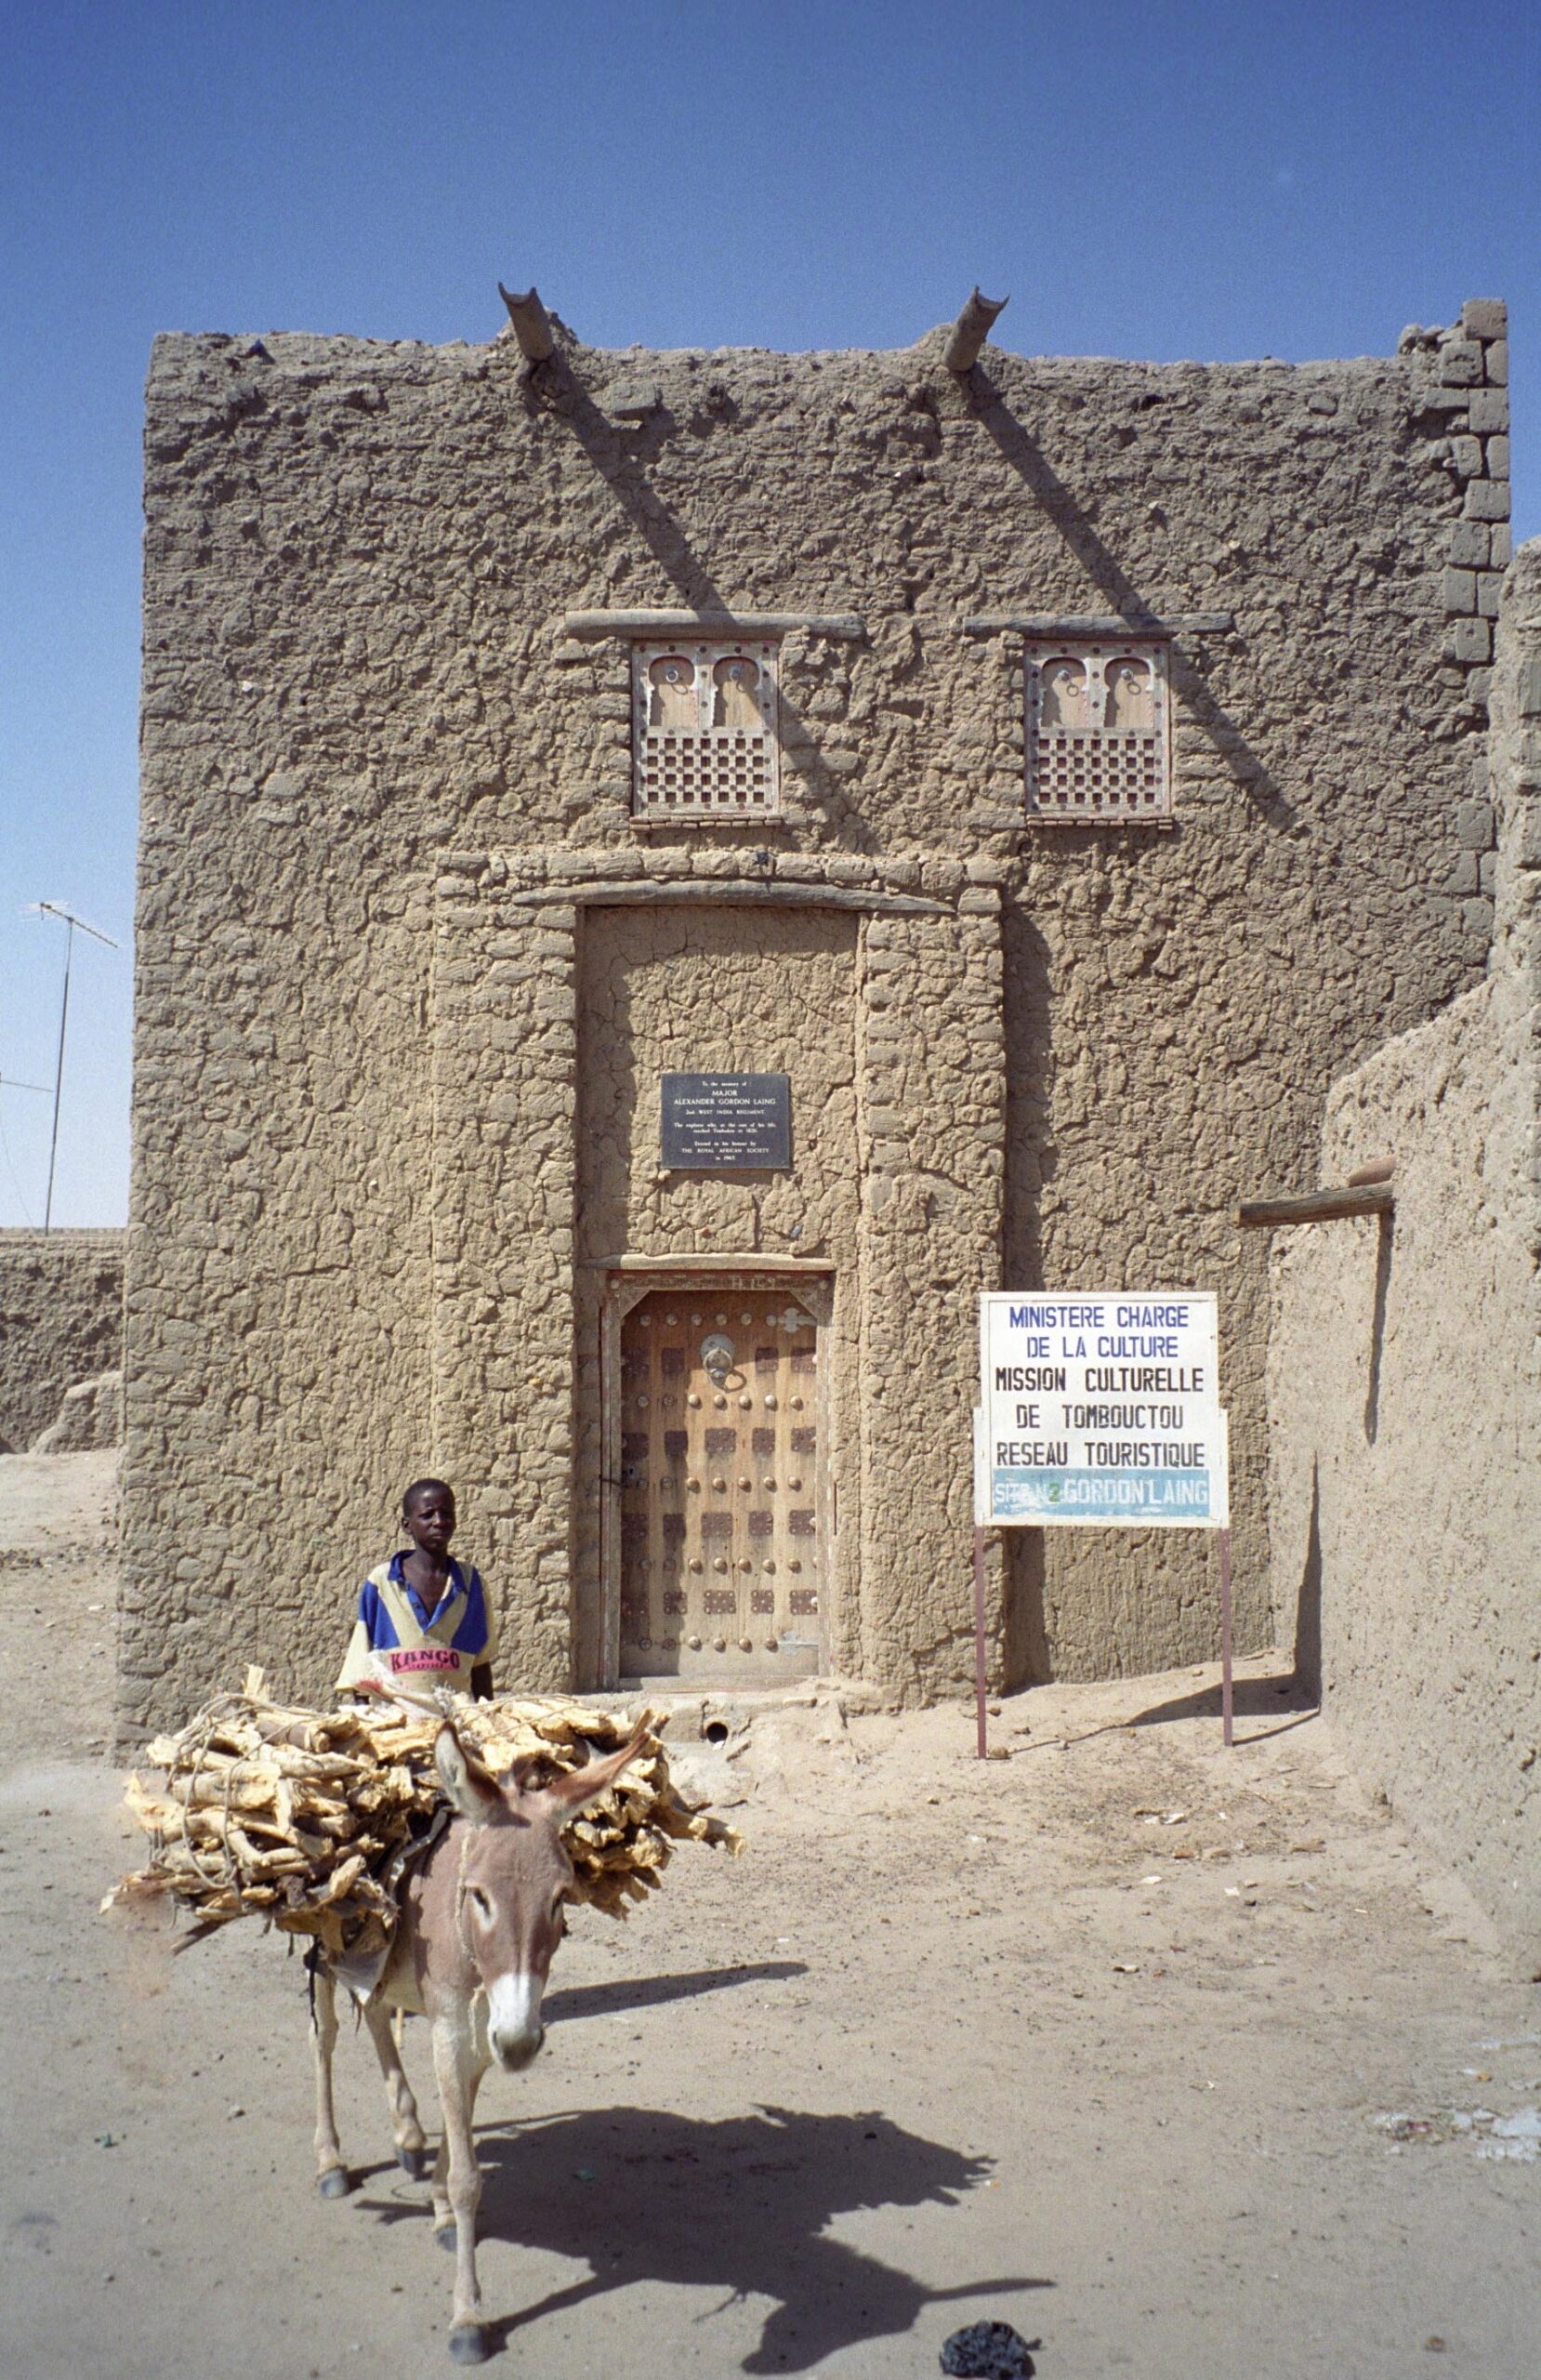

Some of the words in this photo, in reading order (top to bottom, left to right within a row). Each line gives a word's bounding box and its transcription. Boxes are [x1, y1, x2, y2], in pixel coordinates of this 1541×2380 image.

[1008, 1305, 1105, 1329] MINISTERE
[1116, 1305, 1190, 1328] CHARGE
[1027, 1336, 1050, 1358] DE
[1062, 1336, 1087, 1358] LA
[1098, 1336, 1179, 1358] CULTURE
[995, 1367, 1066, 1392] MISSION
[1085, 1368, 1205, 1393] CULTURELLE
[1016, 1404, 1041, 1429] DE
[1062, 1404, 1184, 1430] TOMBOUCTOU
[996, 1441, 1069, 1466] RESEAU
[1085, 1441, 1205, 1468] TOURISTIQUE
[1063, 1479, 1144, 1504] GORDON
[1147, 1480, 1208, 1505] LAING
[390, 1649, 460, 1672] KANGO
